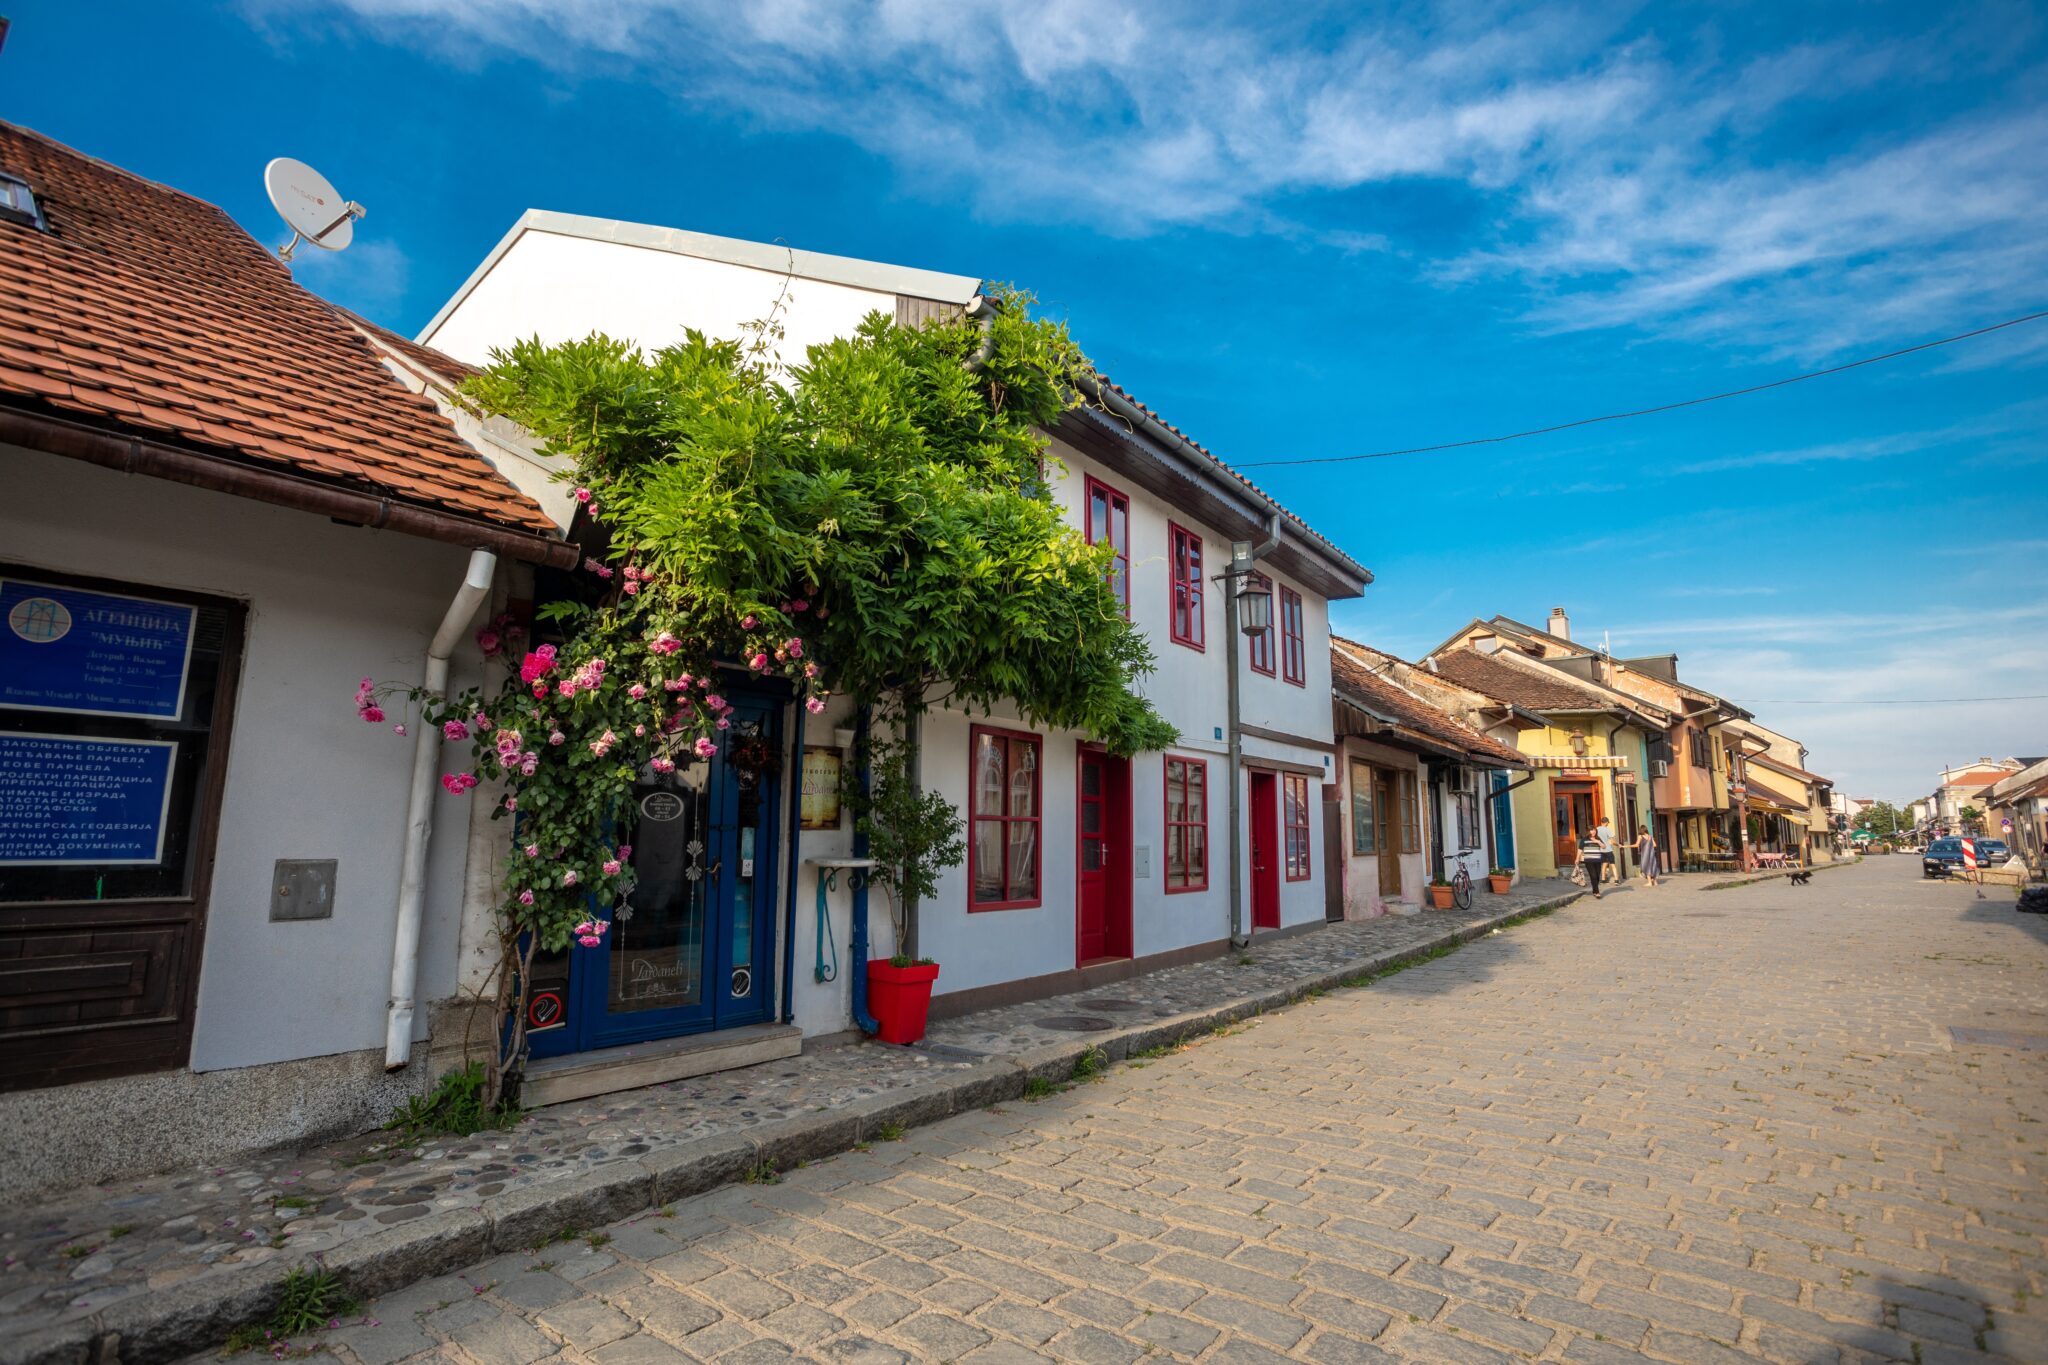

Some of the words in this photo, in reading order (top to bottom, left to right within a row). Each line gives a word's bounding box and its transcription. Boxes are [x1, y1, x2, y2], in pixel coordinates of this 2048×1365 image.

[83, 609, 180, 632] АГЕНЦИЈА
[87, 744, 151, 754] ОБЈЕКАТА
[0, 750, 82, 761] МЕЂАВАЊЕ
[87, 754, 145, 764] ПАРЦЕЛА
[2, 761, 41, 769] ЕОБЕ
[46, 763, 111, 772] ПАРЦЕЛА
[64, 774, 153, 783] ПАРЦЕЛАЦИЈА
[63, 790, 71, 798] И
[76, 791, 127, 799] ИЗРАДА
[80, 822, 152, 830] ГЕОДЕЗИЈА
[56, 842, 142, 850] ДОКУМЕНАТА
